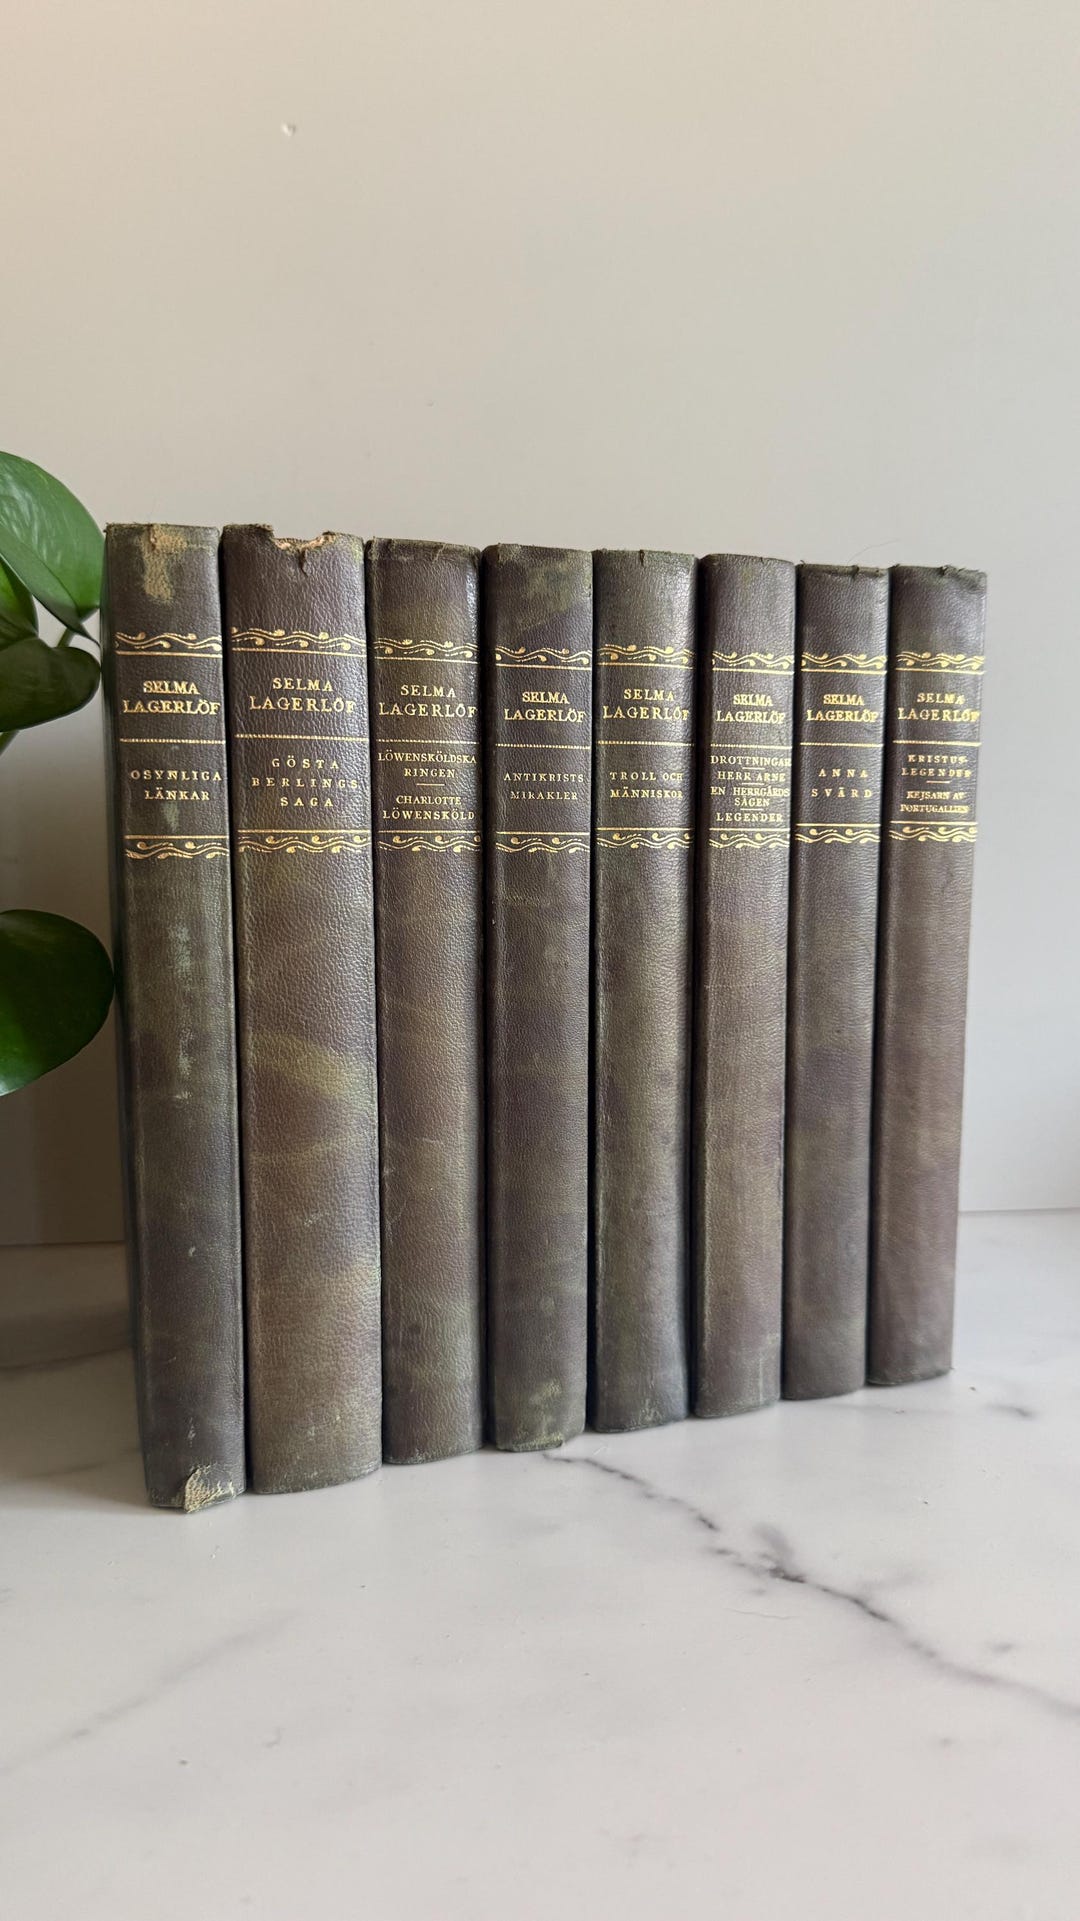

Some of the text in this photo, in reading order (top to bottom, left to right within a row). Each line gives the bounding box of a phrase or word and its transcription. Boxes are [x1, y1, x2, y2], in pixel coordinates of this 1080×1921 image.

[143, 681, 200, 694] SELMA
[272, 678, 333, 692] SELMA
[400, 685, 456, 697] SELMA
[522, 692, 569, 704] SELMA
[624, 689, 674, 701] SELMA
[733, 694, 773, 706] SELMA
[823, 694, 864, 705] SELMA
[917, 693, 965, 704] SELMA
[123, 699, 221, 715] LAGERLÖF
[250, 695, 356, 713] LAGERLÖF
[379, 703, 478, 718] LAGERLÖF
[504, 709, 586, 722] LAGERLÖF
[603, 706, 690, 720] LAGERLÖF
[807, 709, 878, 723] LAGERLÖF
[898, 708, 980, 723] LAGERLÖF
[716, 710, 785, 724] LAGERLÖF
[272, 755, 339, 769] GÖSTA
[378, 750, 477, 763] LÖWENSKÖLDSKA
[711, 755, 792, 767] DROTTNINGAR
[131, 770, 222, 781] OSYNLIGA
[404, 769, 456, 777] RINGEN
[504, 773, 584, 782] ANTIKRISTS
[610, 772, 684, 781] TROLL OCH
[717, 772, 786, 782] HERR ARNE
[819, 769, 868, 777] ANNA
[252, 778, 359, 788] BERLINGS
[145, 788, 210, 800] LÄNKAR
[511, 791, 578, 800] MIRAKLER
[610, 787, 684, 798] MÄNNISKOR
[711, 787, 726, 796] EN
[811, 787, 872, 798] SVÄRD
[906, 791, 950, 801] KEJSARN
[281, 797, 334, 806] SAGA
[396, 796, 461, 805] CHARLOTTE
[383, 808, 474, 820] LÖWENSKÖLD
[716, 813, 783, 822] LEGENDER
